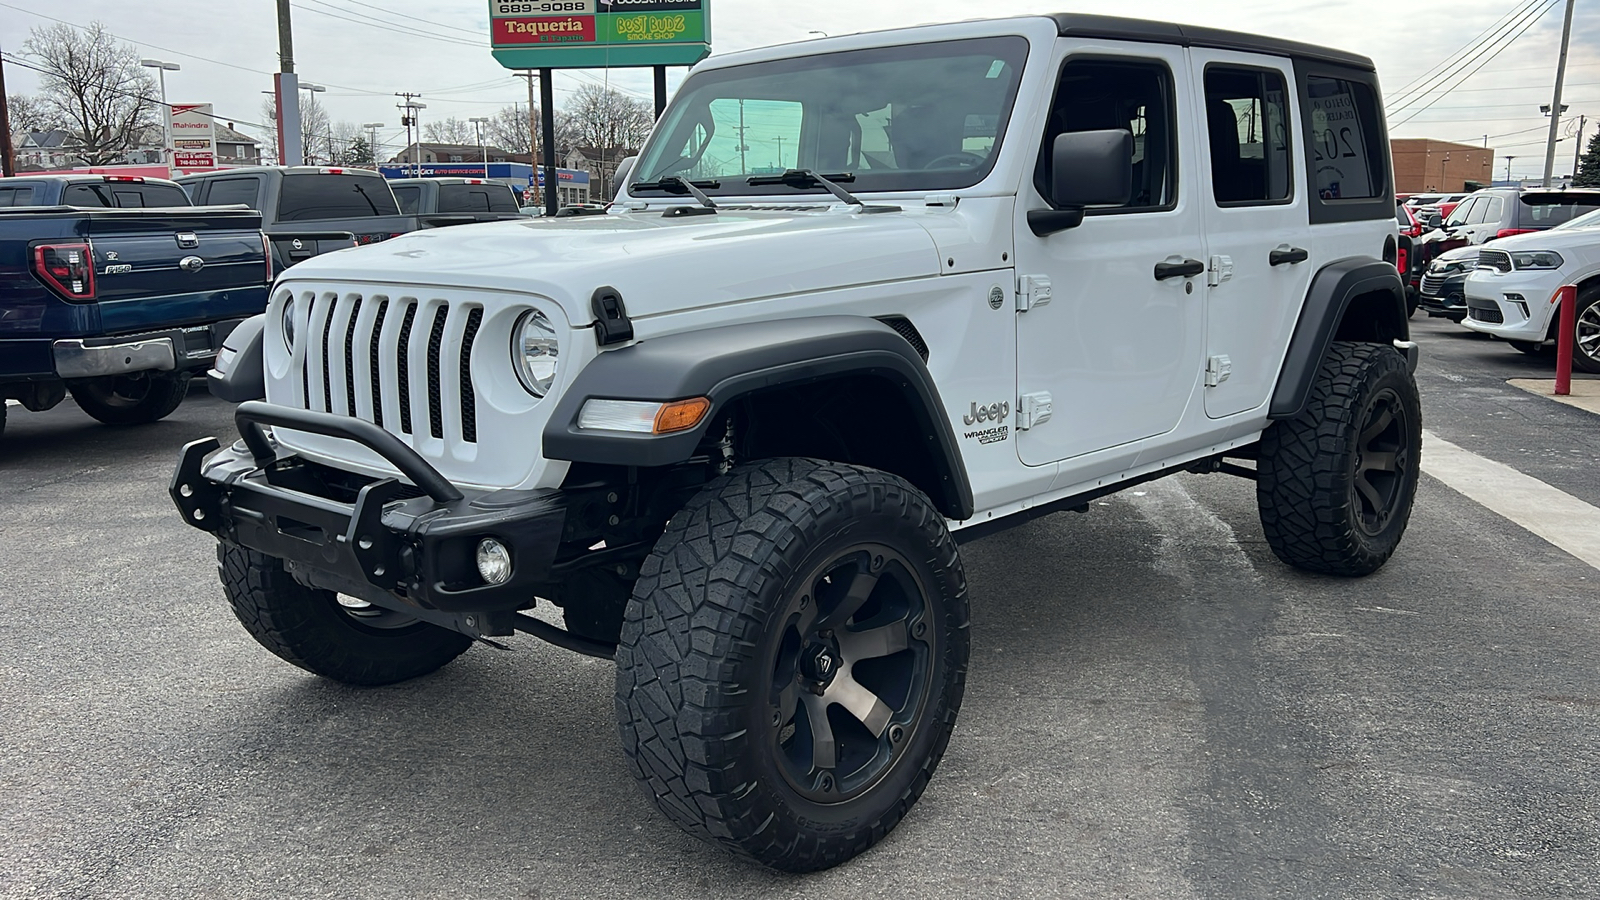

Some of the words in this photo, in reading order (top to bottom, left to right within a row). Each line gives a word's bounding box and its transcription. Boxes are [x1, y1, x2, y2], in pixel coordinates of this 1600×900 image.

[499, 2, 585, 13] 689-9088
[505, 17, 583, 35] Taqueria
[649, 14, 686, 33] BUDZ
[627, 33, 653, 41] SMOKE
[653, 32, 675, 40] SHOP
[962, 400, 1010, 426] Jeep
[963, 425, 1009, 440] WRANGLER
